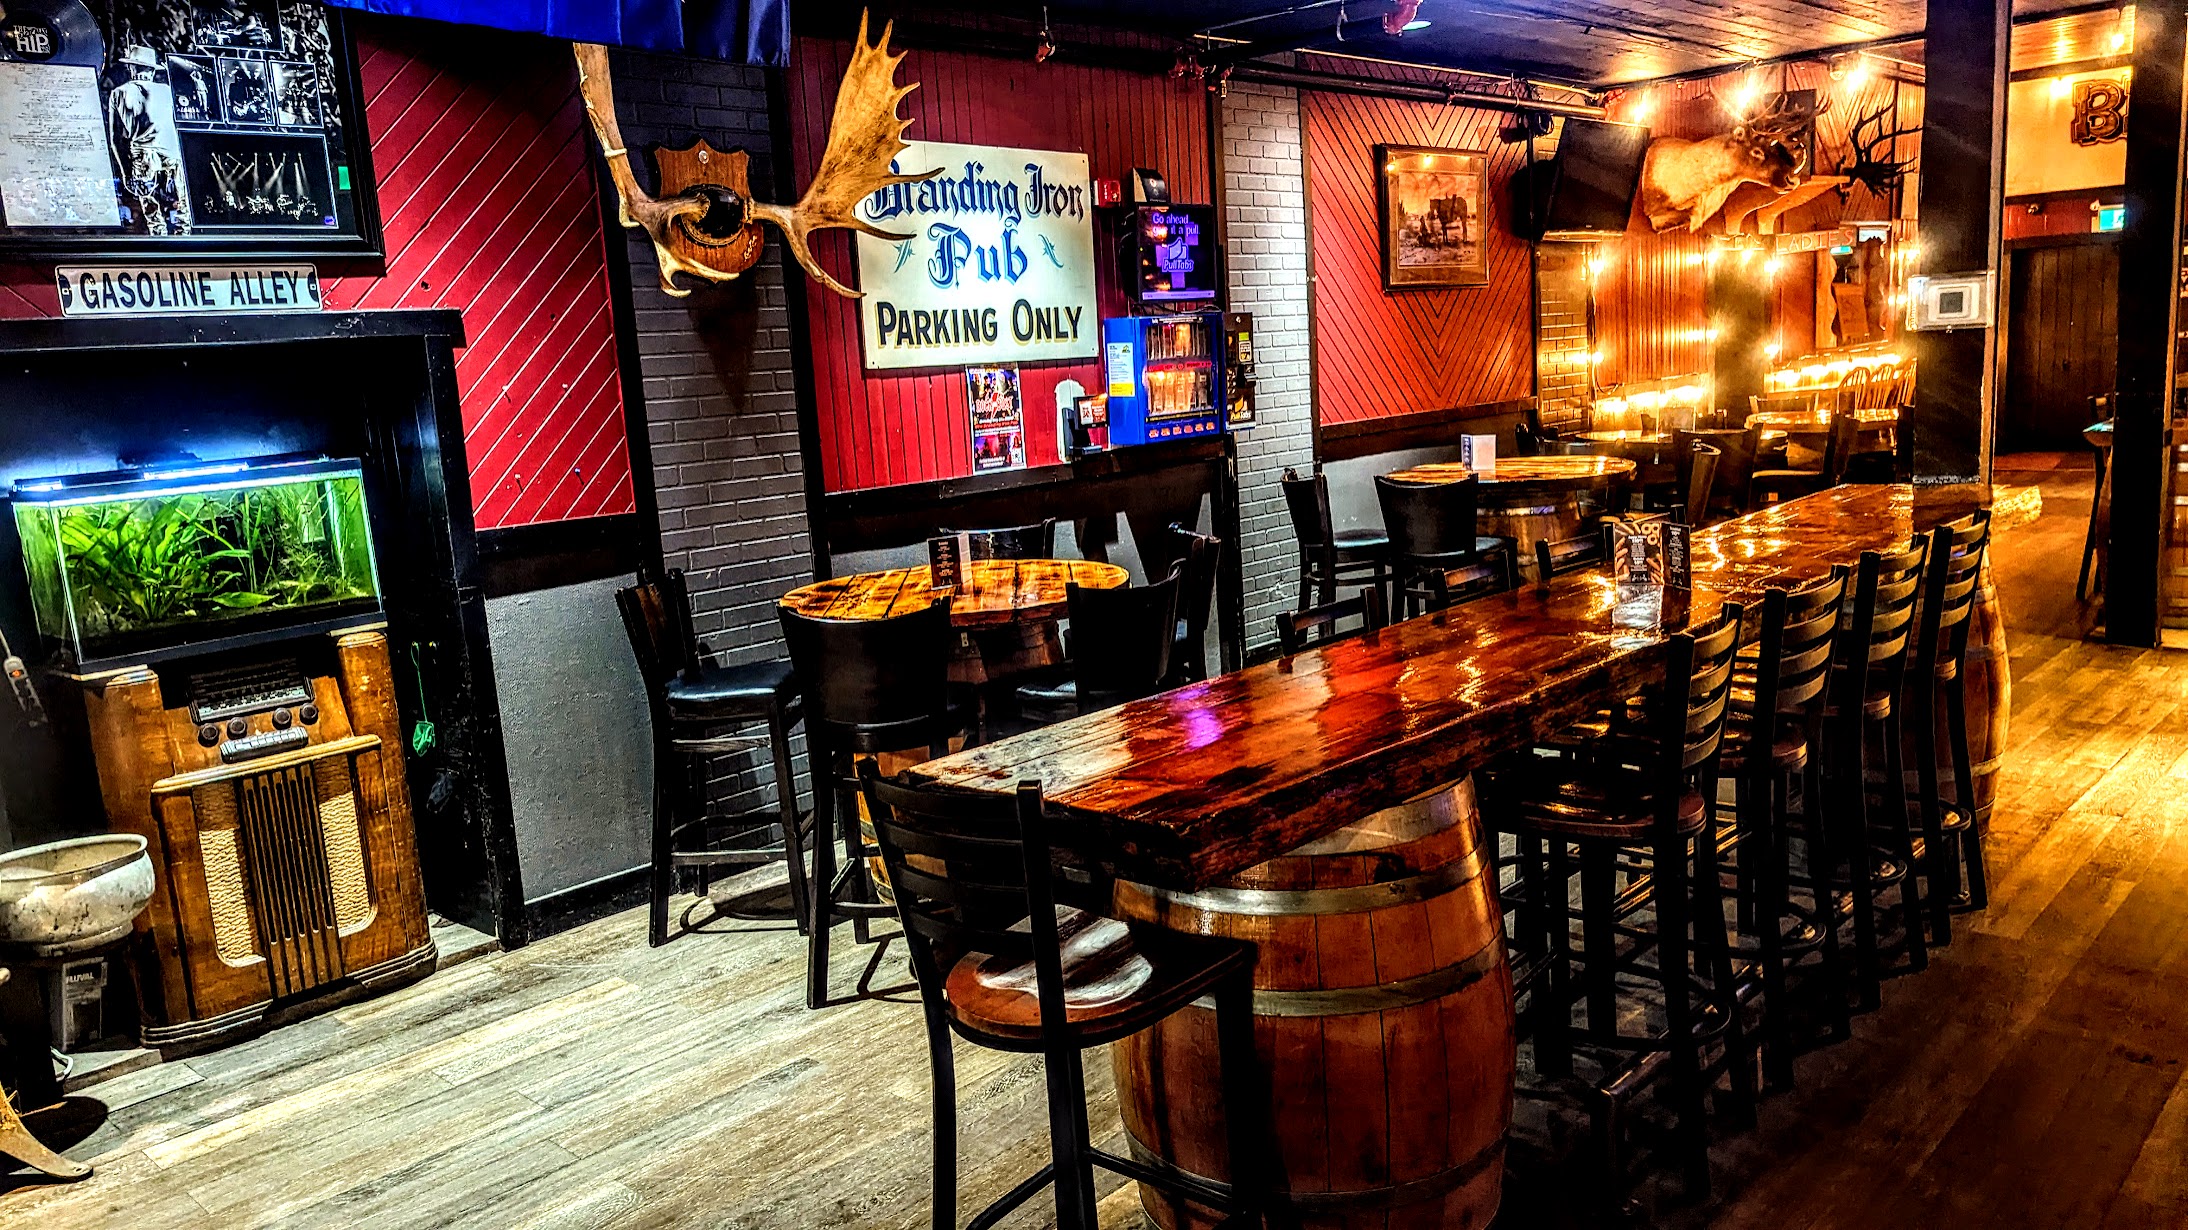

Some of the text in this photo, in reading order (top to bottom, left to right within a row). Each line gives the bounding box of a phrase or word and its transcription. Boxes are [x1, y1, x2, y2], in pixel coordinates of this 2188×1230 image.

[16, 34, 50, 53] HIP
[865, 159, 1084, 227] Branding Iron
[1152, 213, 1189, 225] Go ahead
[928, 222, 1028, 289] Pub
[1776, 230, 1854, 251] LADIES
[80, 270, 299, 309] GASOLINE ALLEY
[875, 298, 1083, 349] PARKING ONLY
